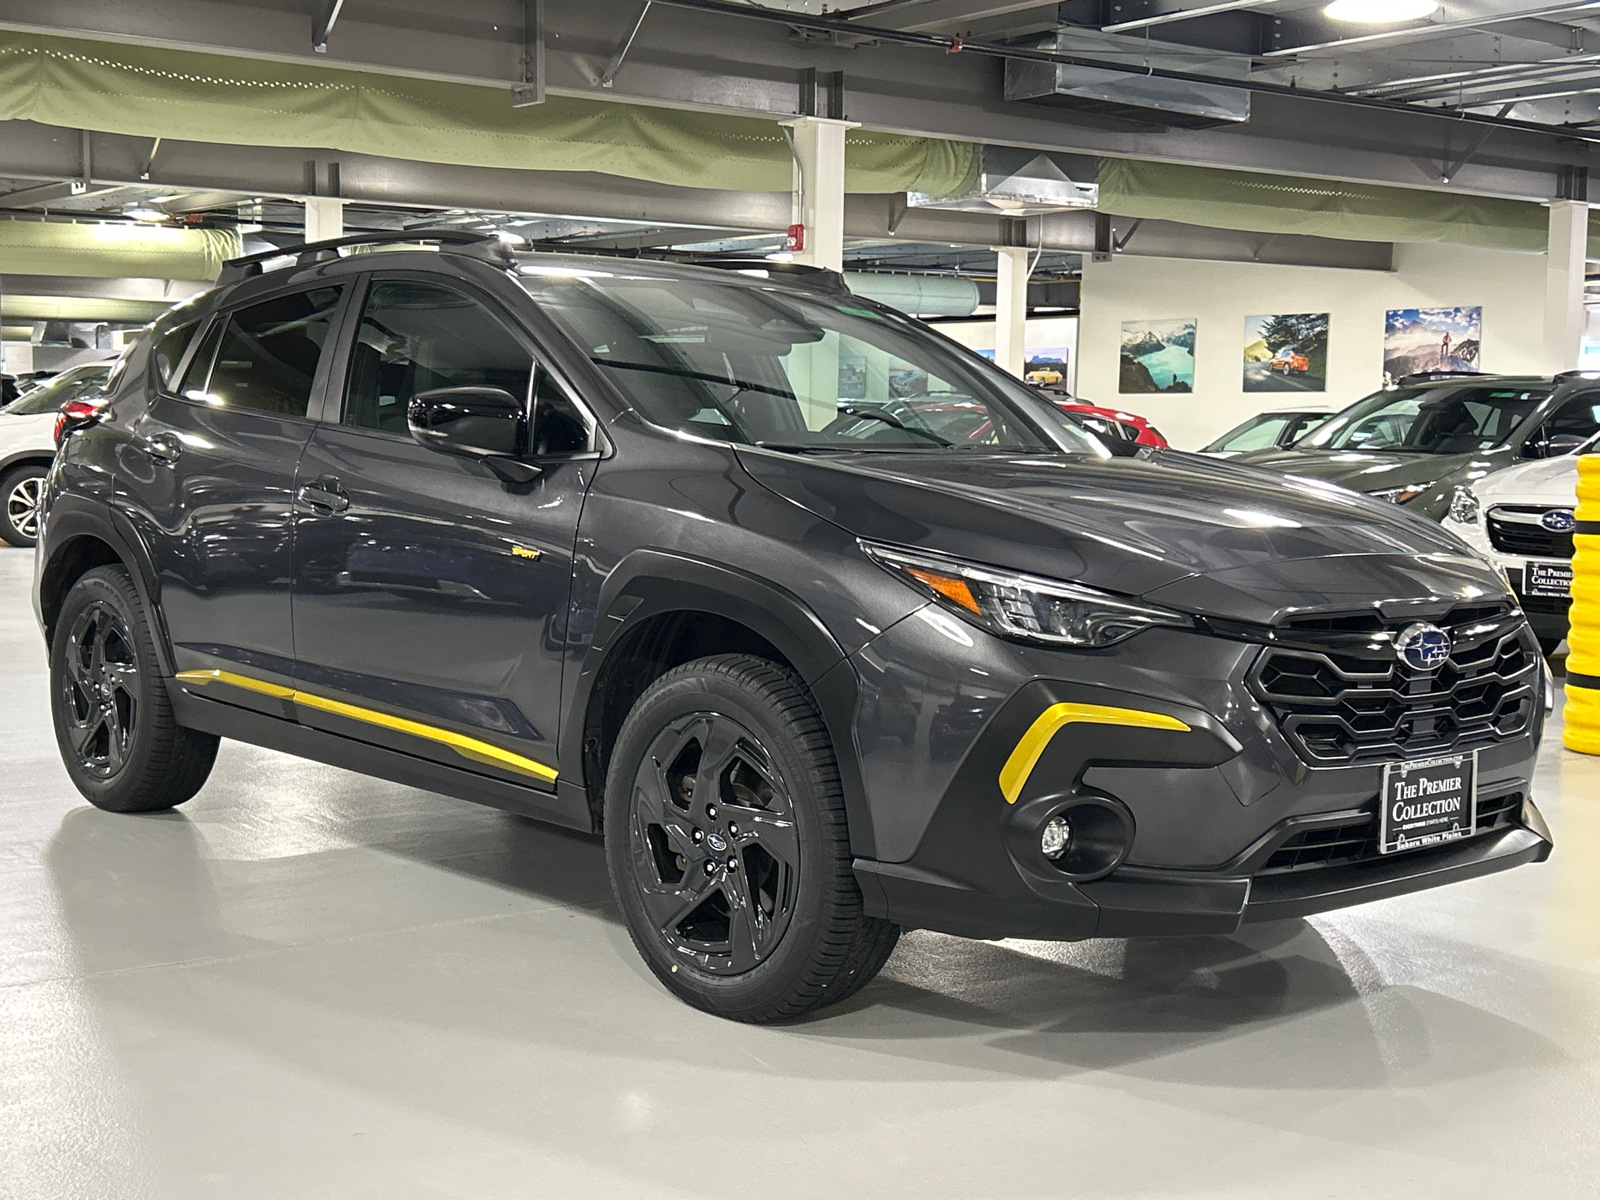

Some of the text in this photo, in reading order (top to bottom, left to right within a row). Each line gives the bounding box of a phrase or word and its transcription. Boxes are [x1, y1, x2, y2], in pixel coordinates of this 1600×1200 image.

[1531, 576, 1572, 586] COLLECTIO
[1532, 567, 1547, 577] THE
[1394, 777, 1462, 801] THE PREMIER
[1392, 797, 1461, 822] COLLECTION
[1396, 831, 1462, 850] Subaru White Plains
